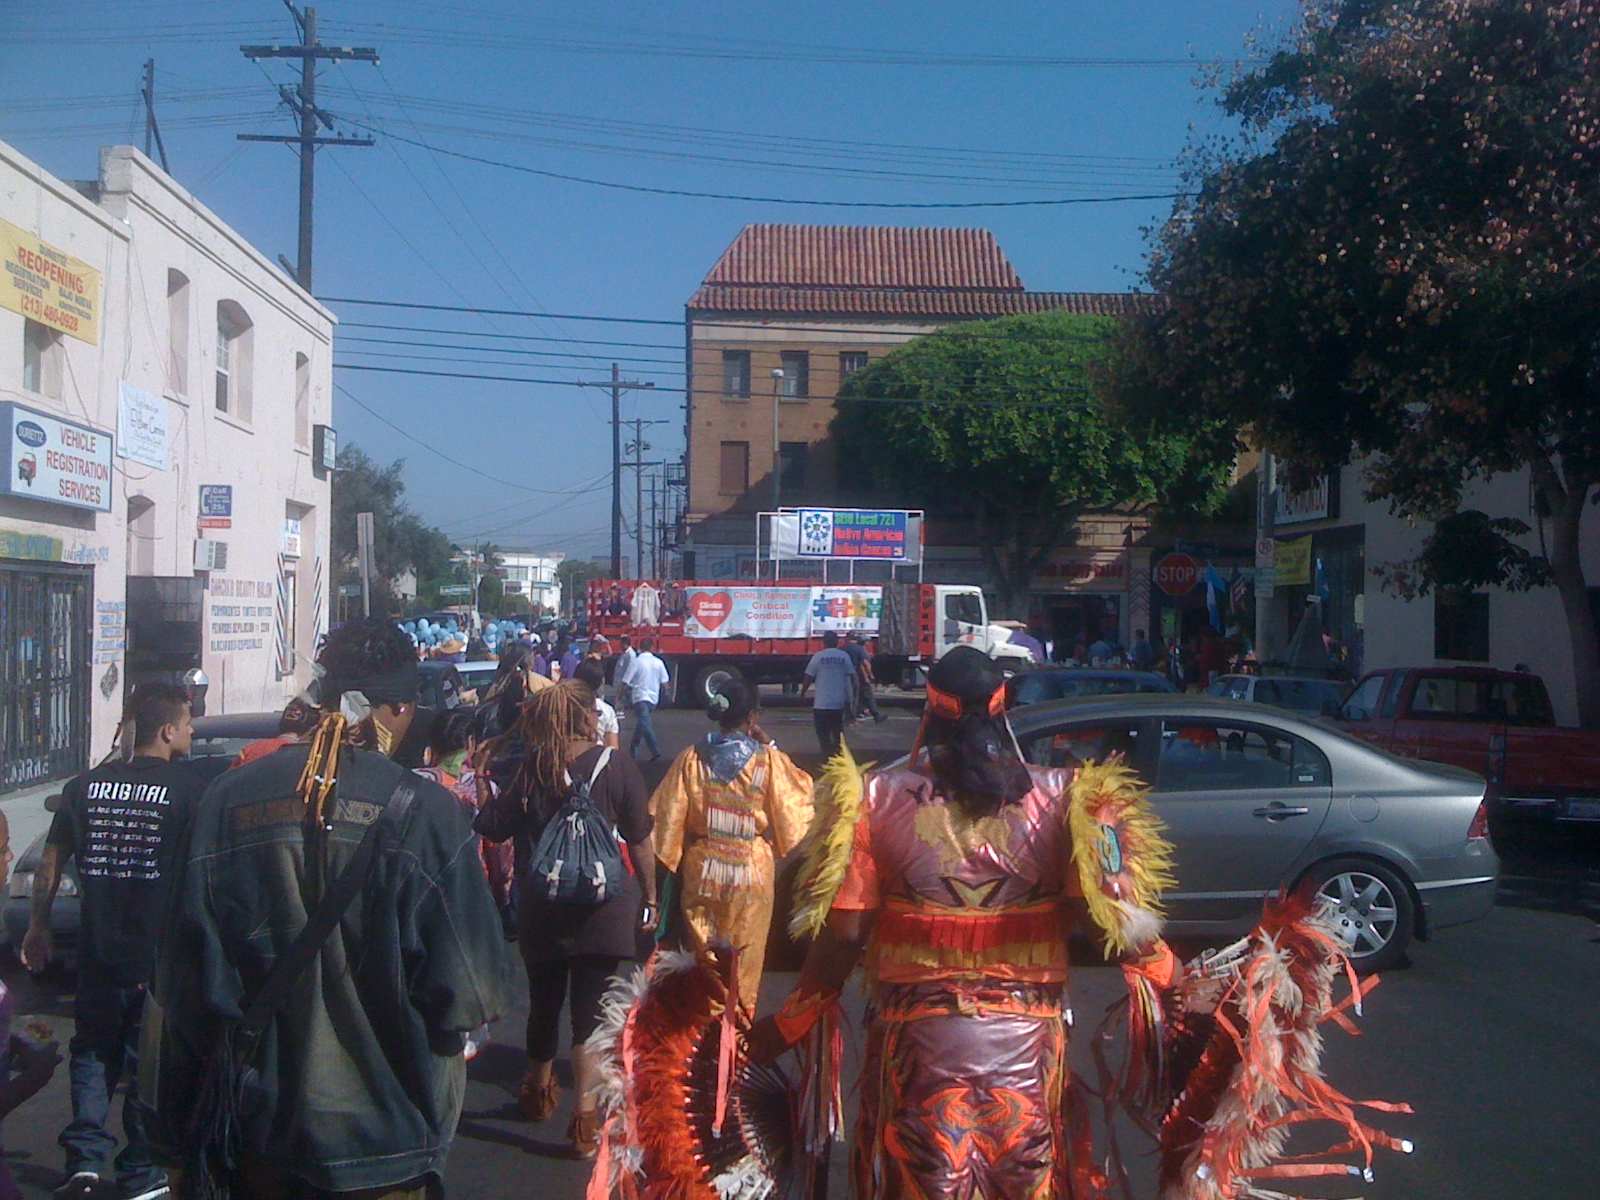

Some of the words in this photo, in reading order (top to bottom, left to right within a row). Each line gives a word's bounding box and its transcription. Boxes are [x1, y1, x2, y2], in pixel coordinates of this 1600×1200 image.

[18, 246, 84, 294] REOPENING
[21, 293, 42, 320] (213)
[60, 427, 96, 453] VEHICLE
[46, 450, 109, 482] REGISTRATION
[58, 478, 101, 504] SERVICES
[880, 513, 895, 526] 721
[1159, 567, 1195, 582] STOP
[732, 591, 763, 600] Clinica
[765, 591, 797, 600] Romero
[752, 601, 789, 610] Critical
[746, 611, 795, 620] Condition
